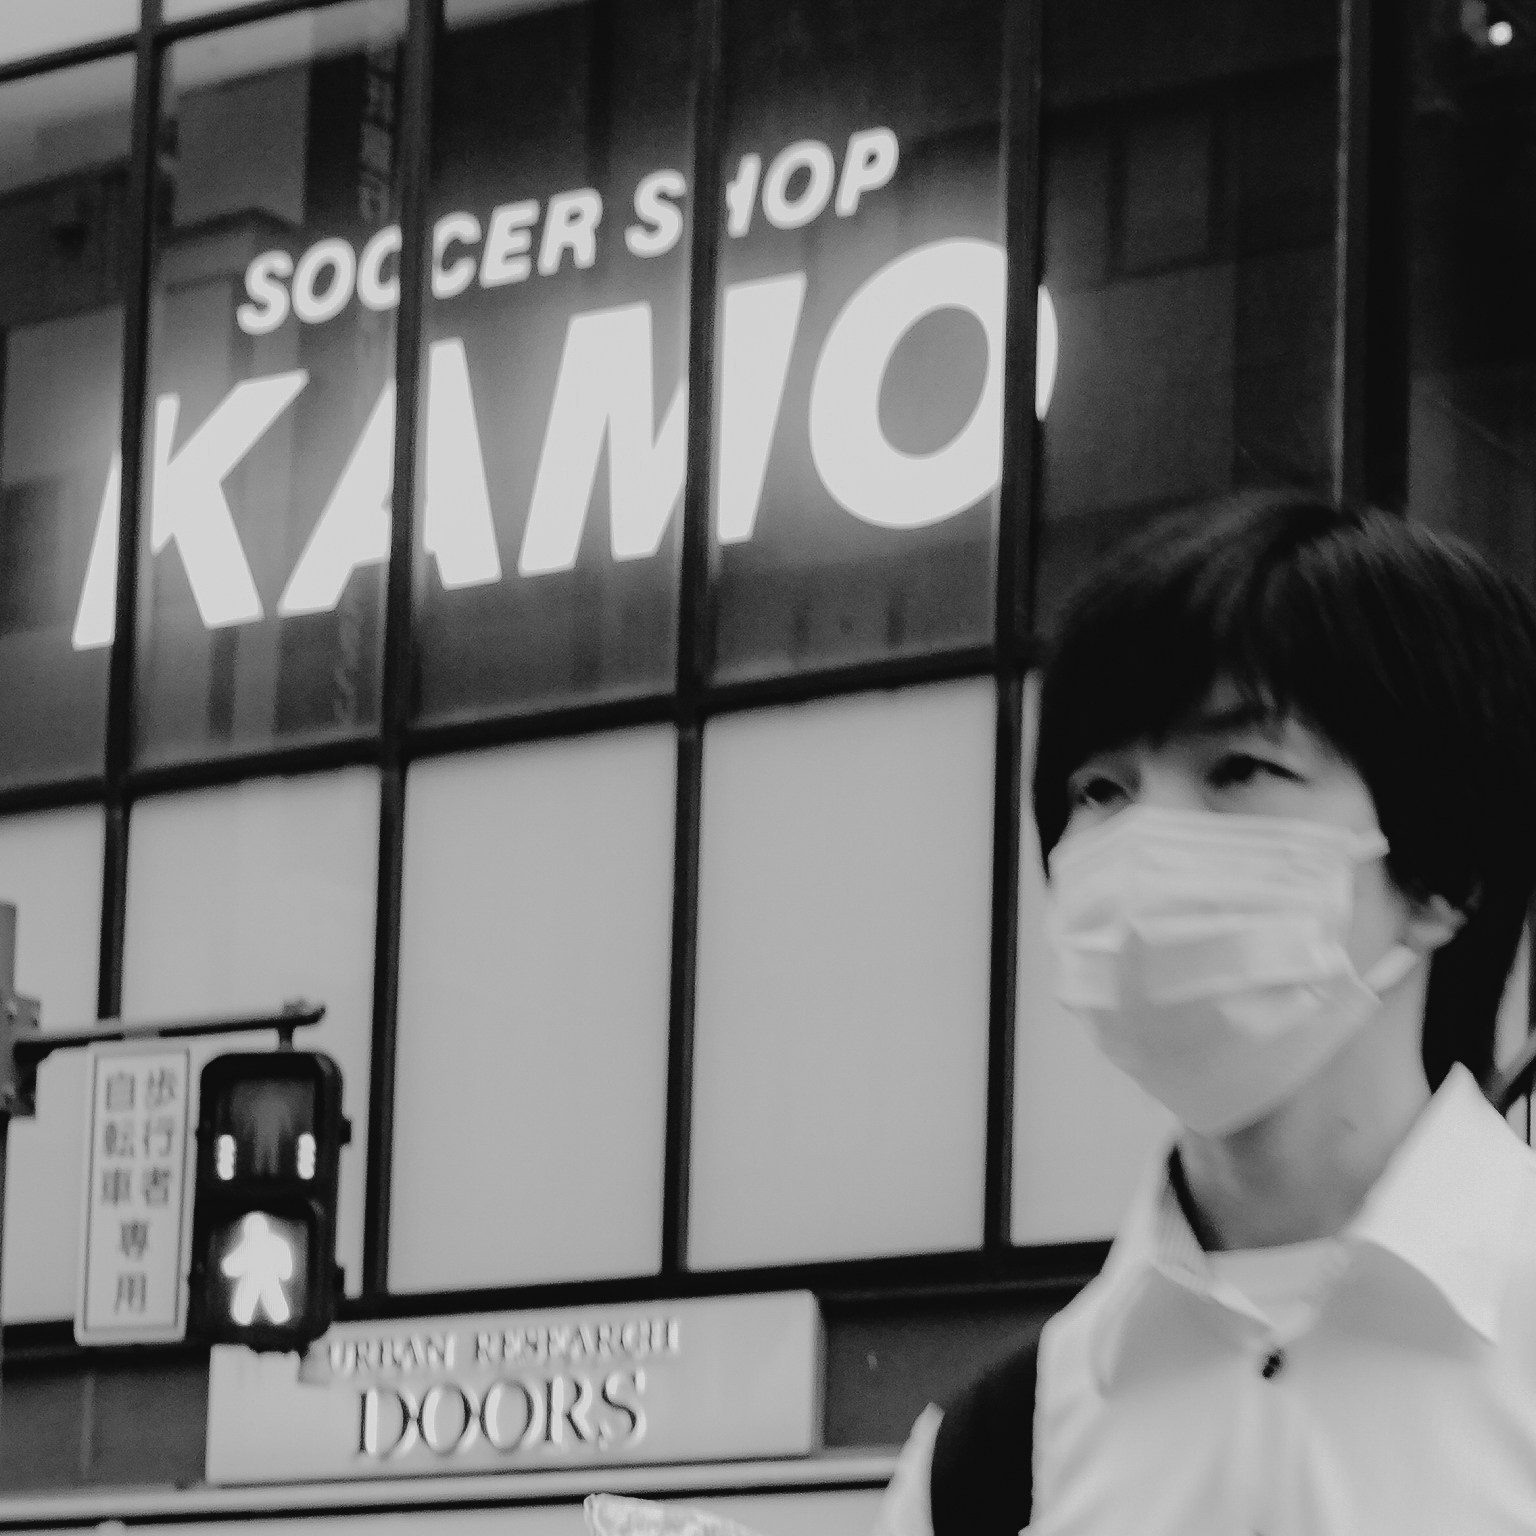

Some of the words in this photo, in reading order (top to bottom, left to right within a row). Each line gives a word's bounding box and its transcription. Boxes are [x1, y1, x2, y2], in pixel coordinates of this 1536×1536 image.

[235, 187, 603, 335] SOCCER
[71, 236, 1059, 651] KAMO
[359, 1367, 648, 1460] DOORS
